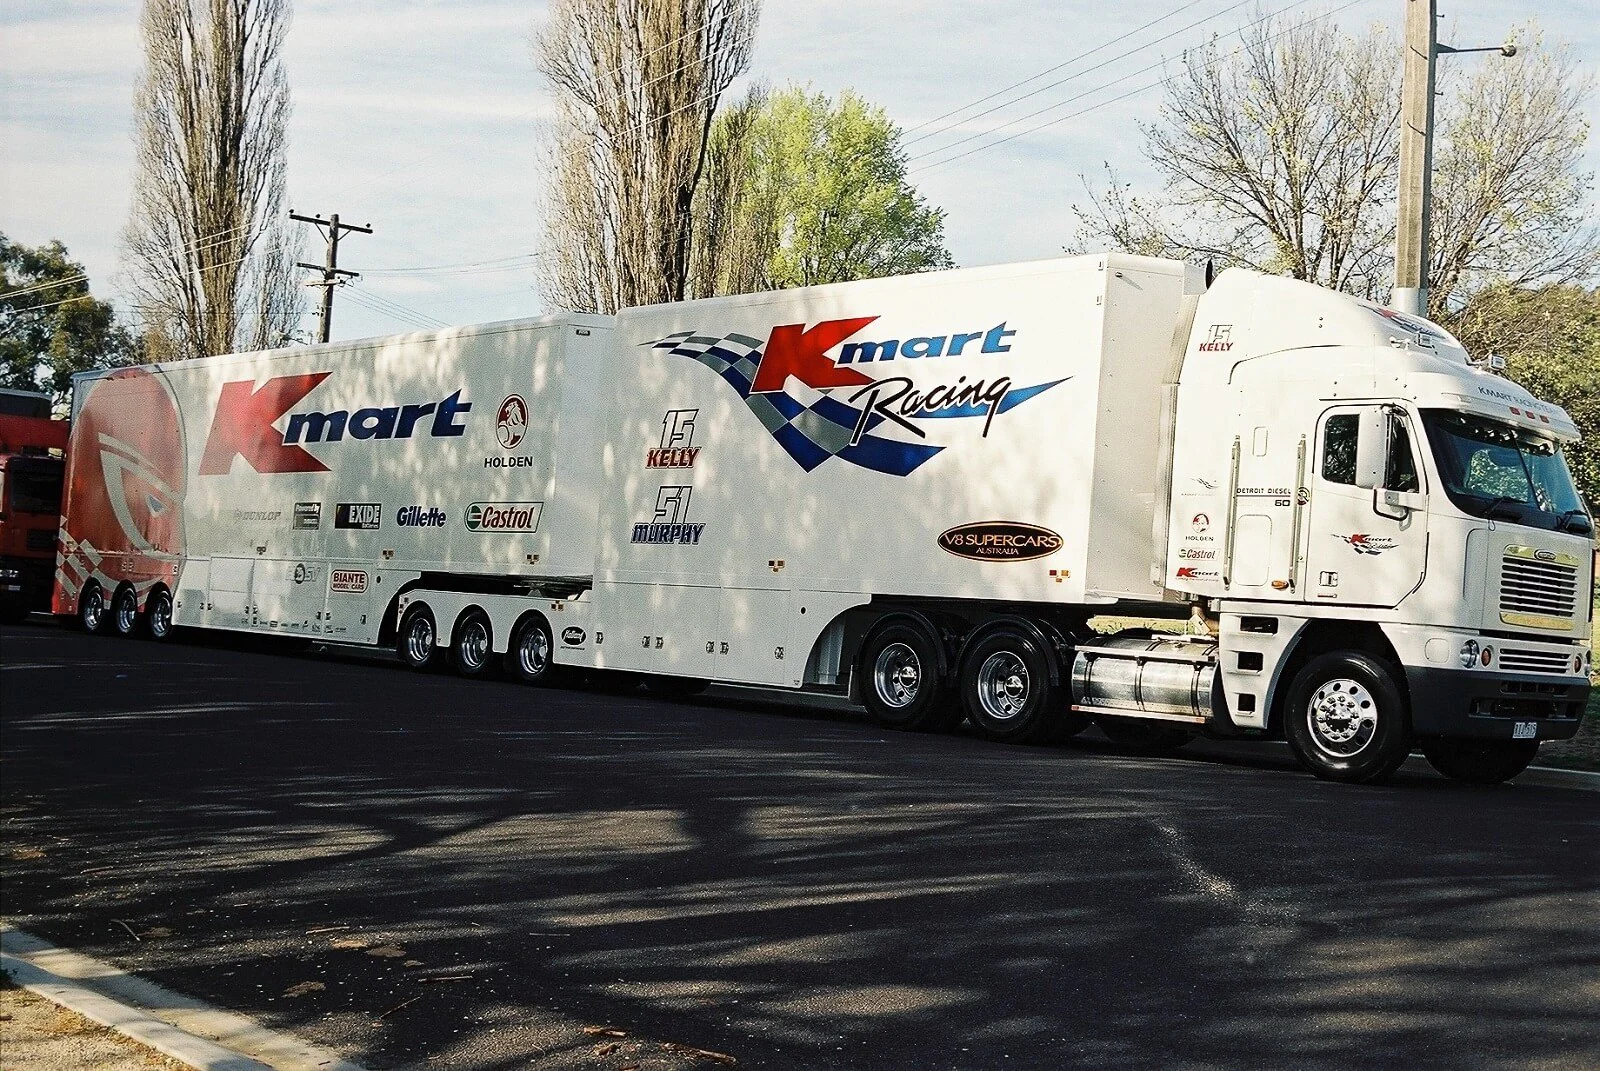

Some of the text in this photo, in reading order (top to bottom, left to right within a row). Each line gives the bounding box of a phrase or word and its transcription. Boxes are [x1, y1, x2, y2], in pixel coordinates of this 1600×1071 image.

[750, 315, 1017, 395] Kmart
[1199, 342, 1234, 352] KELLY
[848, 375, 1011, 446] Racing
[198, 371, 472, 476] Kmart
[660, 408, 699, 448] 15
[484, 456, 533, 469] HOLDEN
[645, 447, 702, 469] KELLY
[349, 505, 380, 523] EXIDE
[650, 485, 693, 524] 51
[397, 506, 447, 527] Gillette
[480, 505, 535, 530] Castrol
[631, 523, 706, 545] MURPHY
[944, 534, 1060, 548] V8 SUPERCARS
[976, 547, 1019, 556] AUSTRALIA
[1187, 548, 1216, 559] Castrol
[333, 572, 366, 583] BIANTE
[1176, 567, 1219, 578] Kmart
